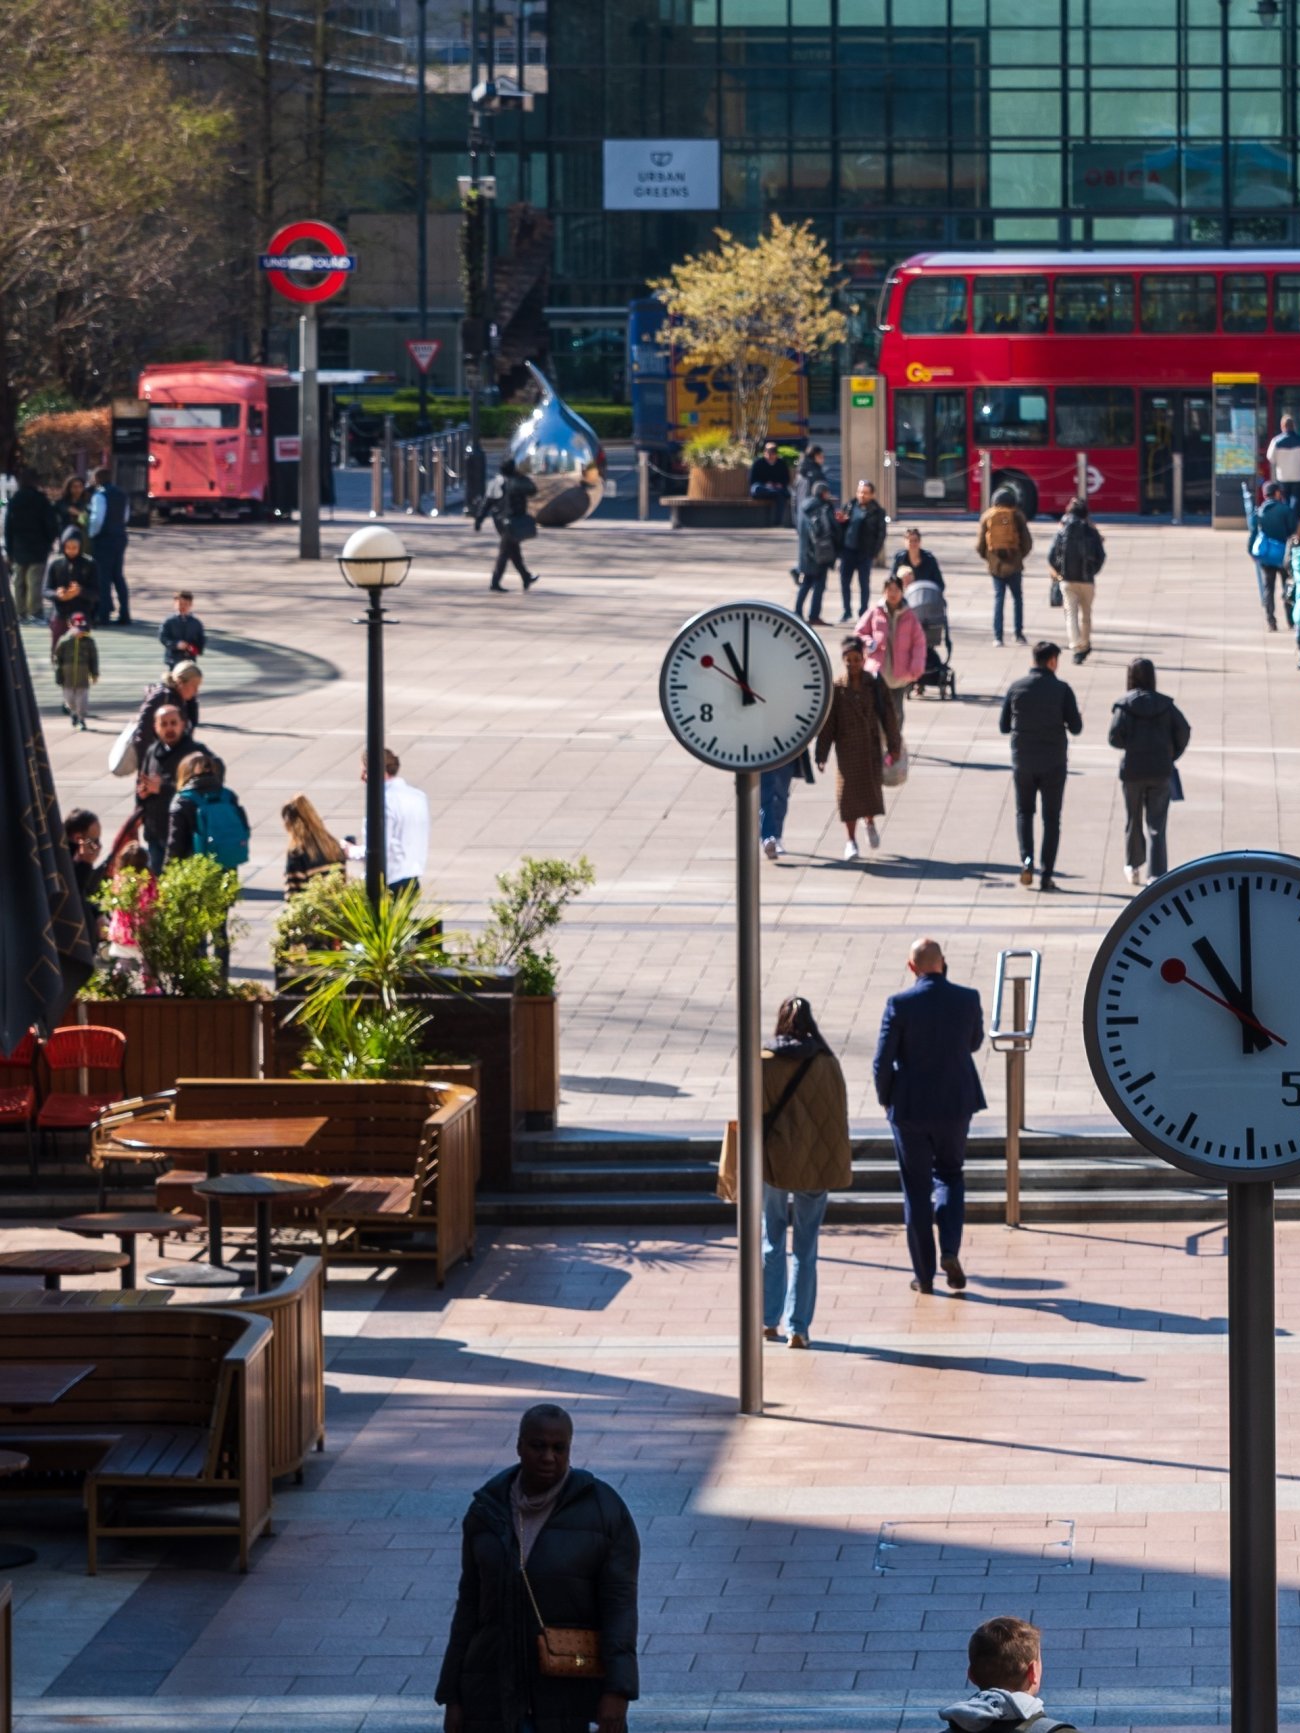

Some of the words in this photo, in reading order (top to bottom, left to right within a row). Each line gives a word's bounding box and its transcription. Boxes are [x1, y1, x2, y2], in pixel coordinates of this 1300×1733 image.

[638, 171, 686, 182] URBAN
[633, 186, 690, 198] GREENS
[700, 703, 713, 722] 8
